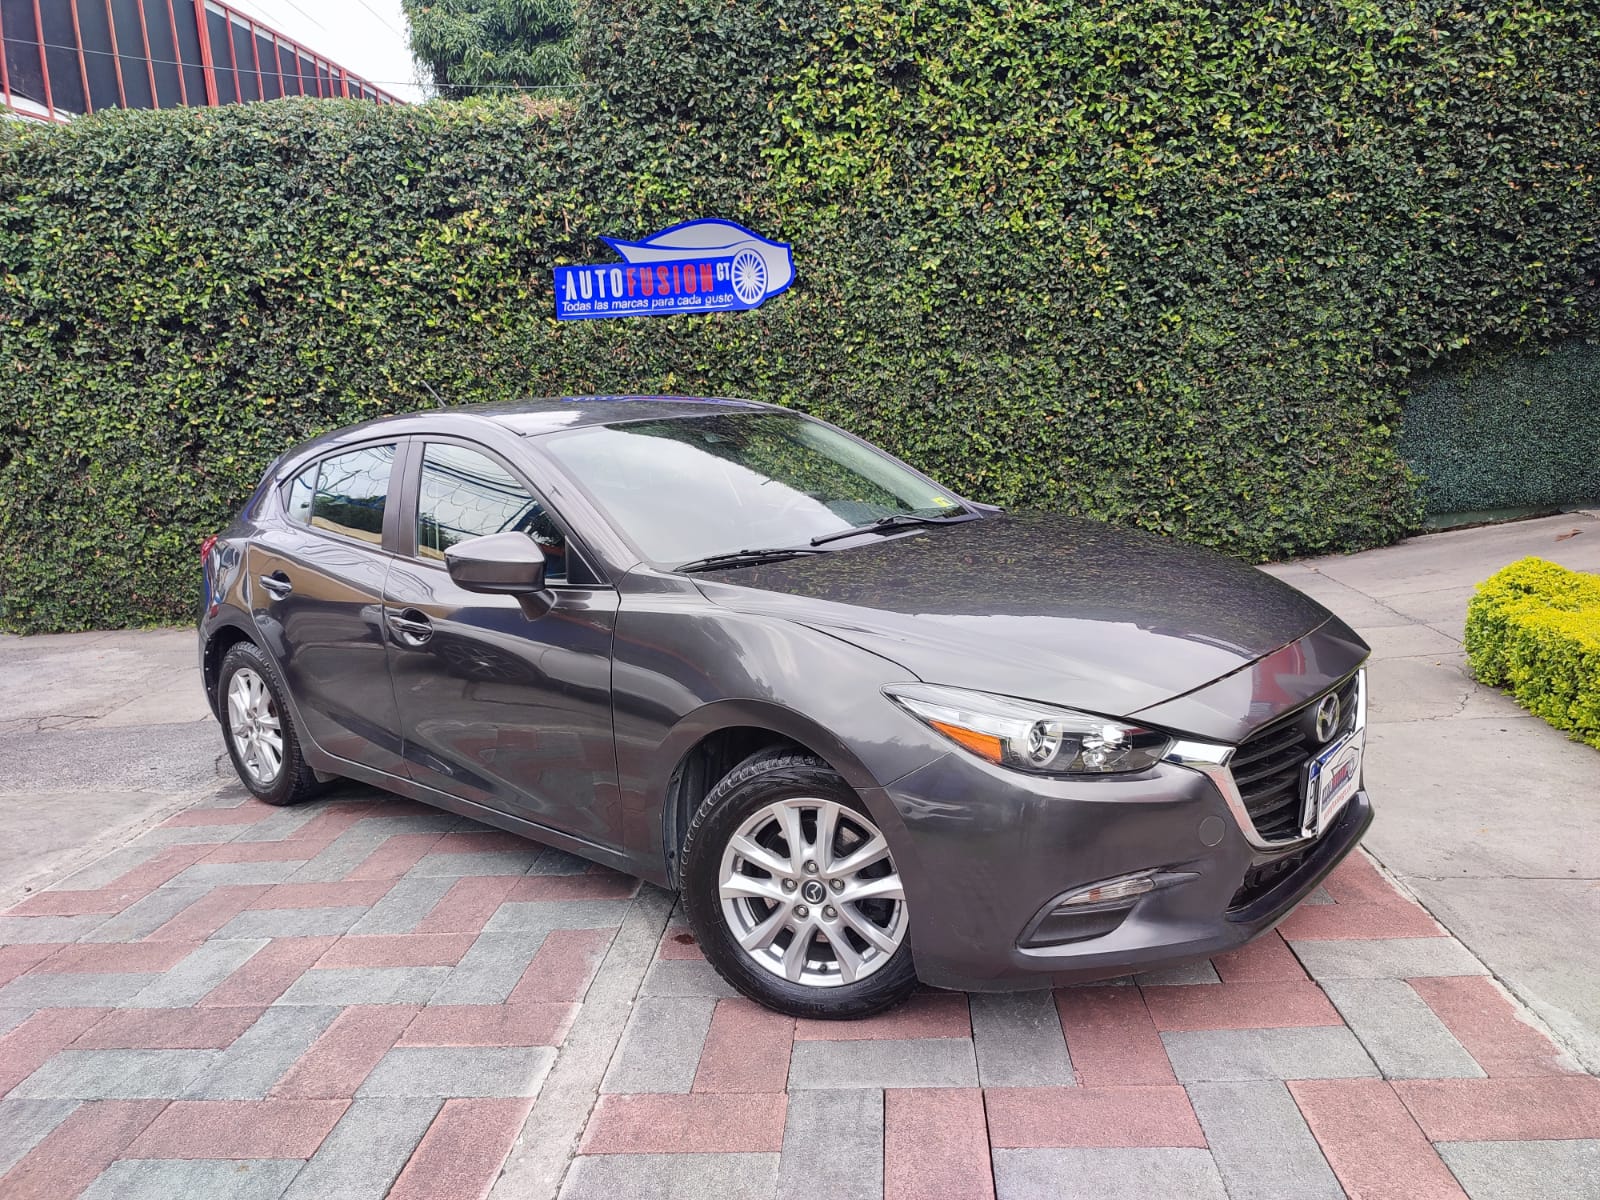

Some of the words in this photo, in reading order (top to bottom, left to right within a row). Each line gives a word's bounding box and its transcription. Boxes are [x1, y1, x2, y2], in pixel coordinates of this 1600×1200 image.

[716, 262, 730, 281] GT
[562, 301, 592, 312] Todas
[594, 300, 609, 310] las
[612, 298, 649, 309] marcas
[652, 297, 675, 310] para
[677, 294, 702, 305] cada
[705, 293, 734, 306] gusto
